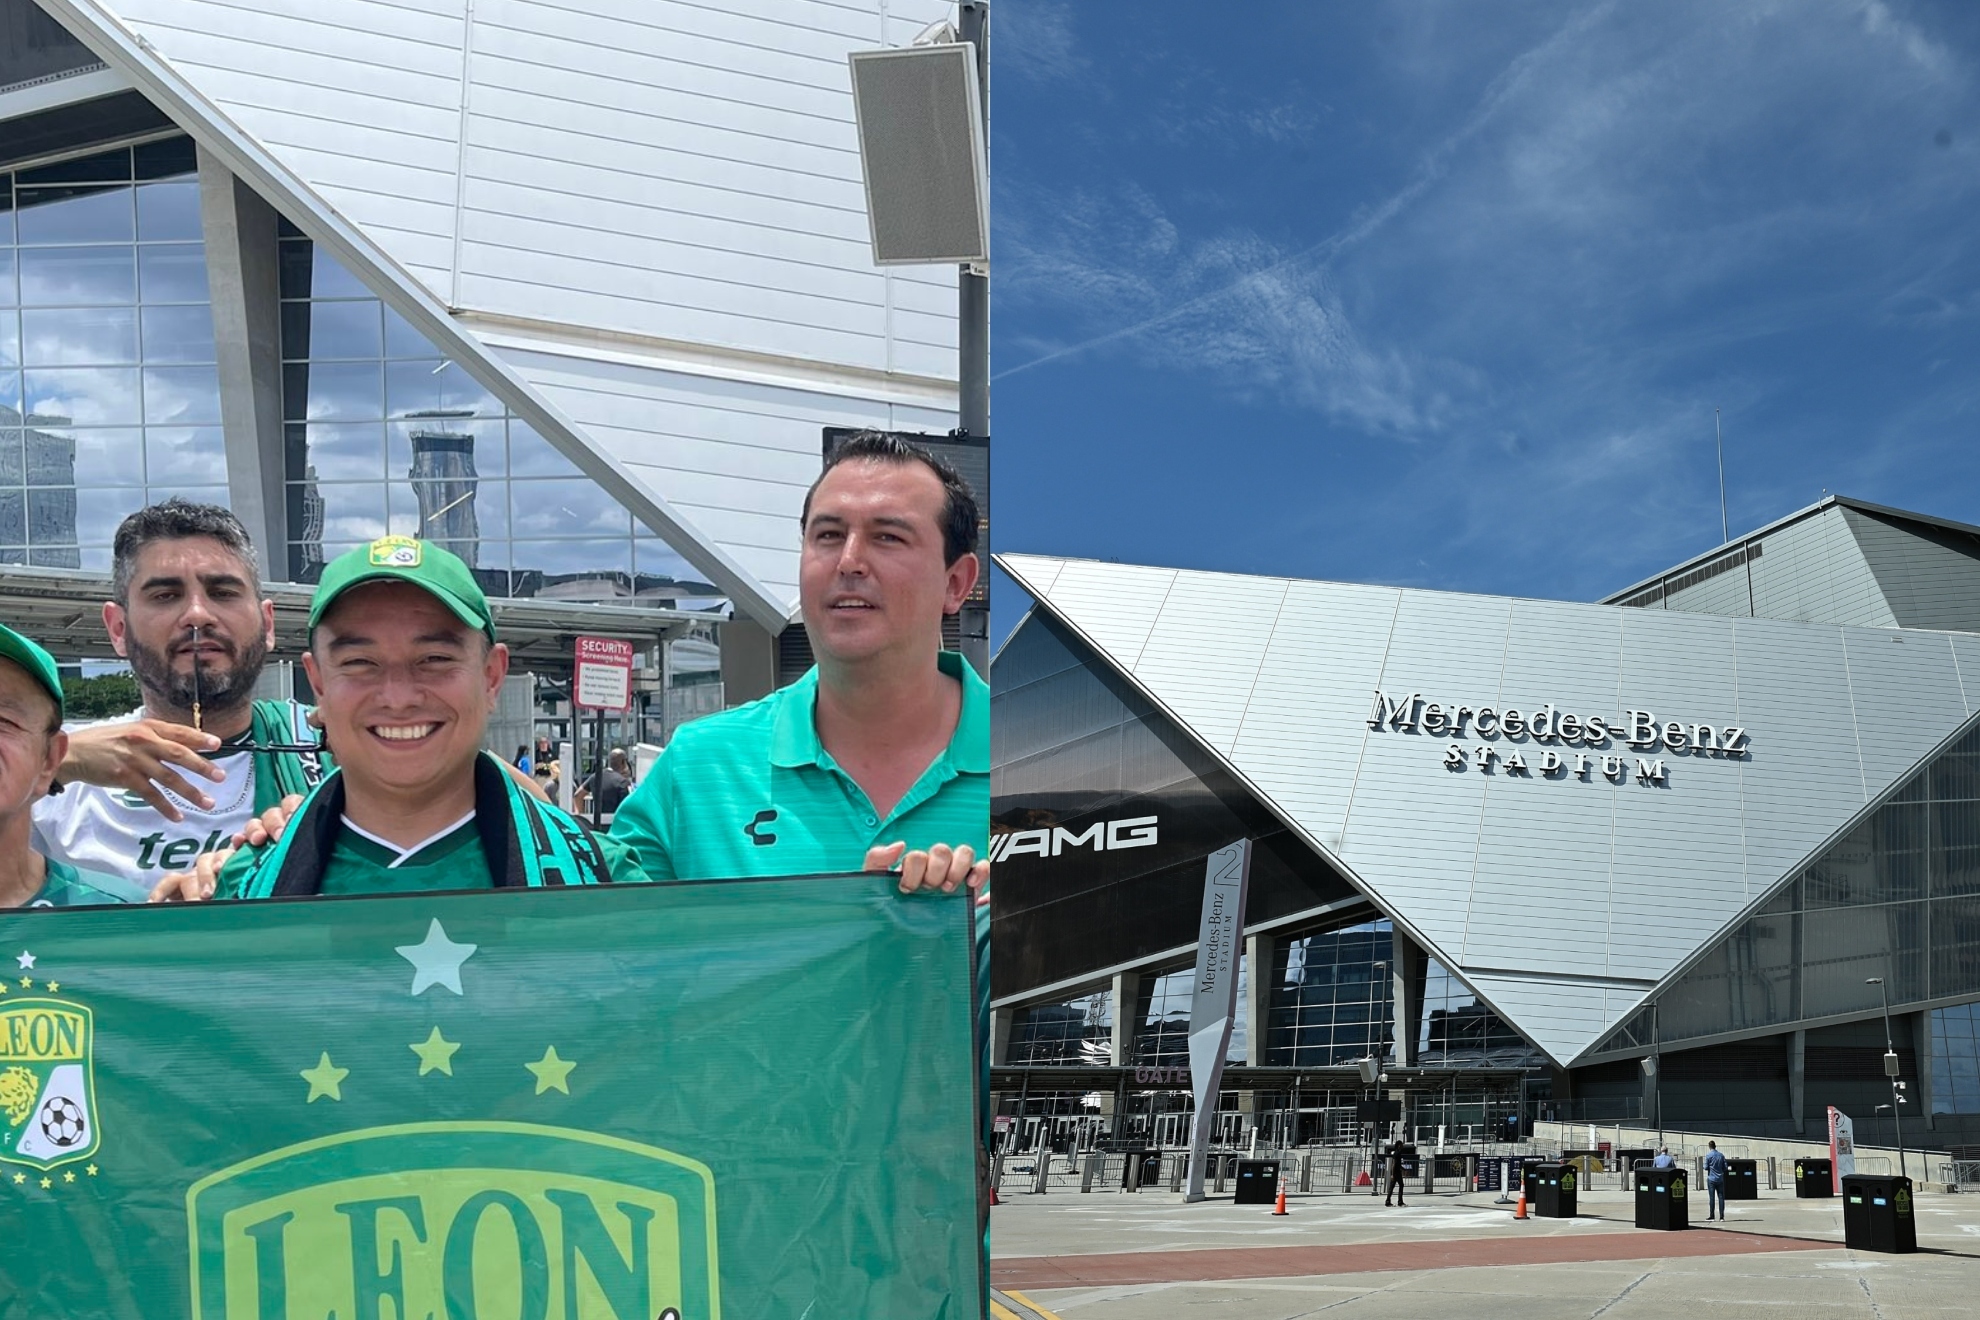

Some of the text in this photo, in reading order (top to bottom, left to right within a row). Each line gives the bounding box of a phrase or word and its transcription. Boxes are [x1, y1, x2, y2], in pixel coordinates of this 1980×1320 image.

[582, 640, 628, 655] SECURITY
[1367, 690, 1746, 753] Mercedes-Benz
[1443, 743, 1665, 781] STADIUM
[997, 815, 1158, 863] AMG
[1201, 893, 1224, 994] Mercedes-Benz
[1219, 915, 1233, 971] STADIUM
[0, 1013, 79, 1057] EON
[1135, 1066, 1188, 1084] GATE
[244, 1189, 656, 1320] LEON
